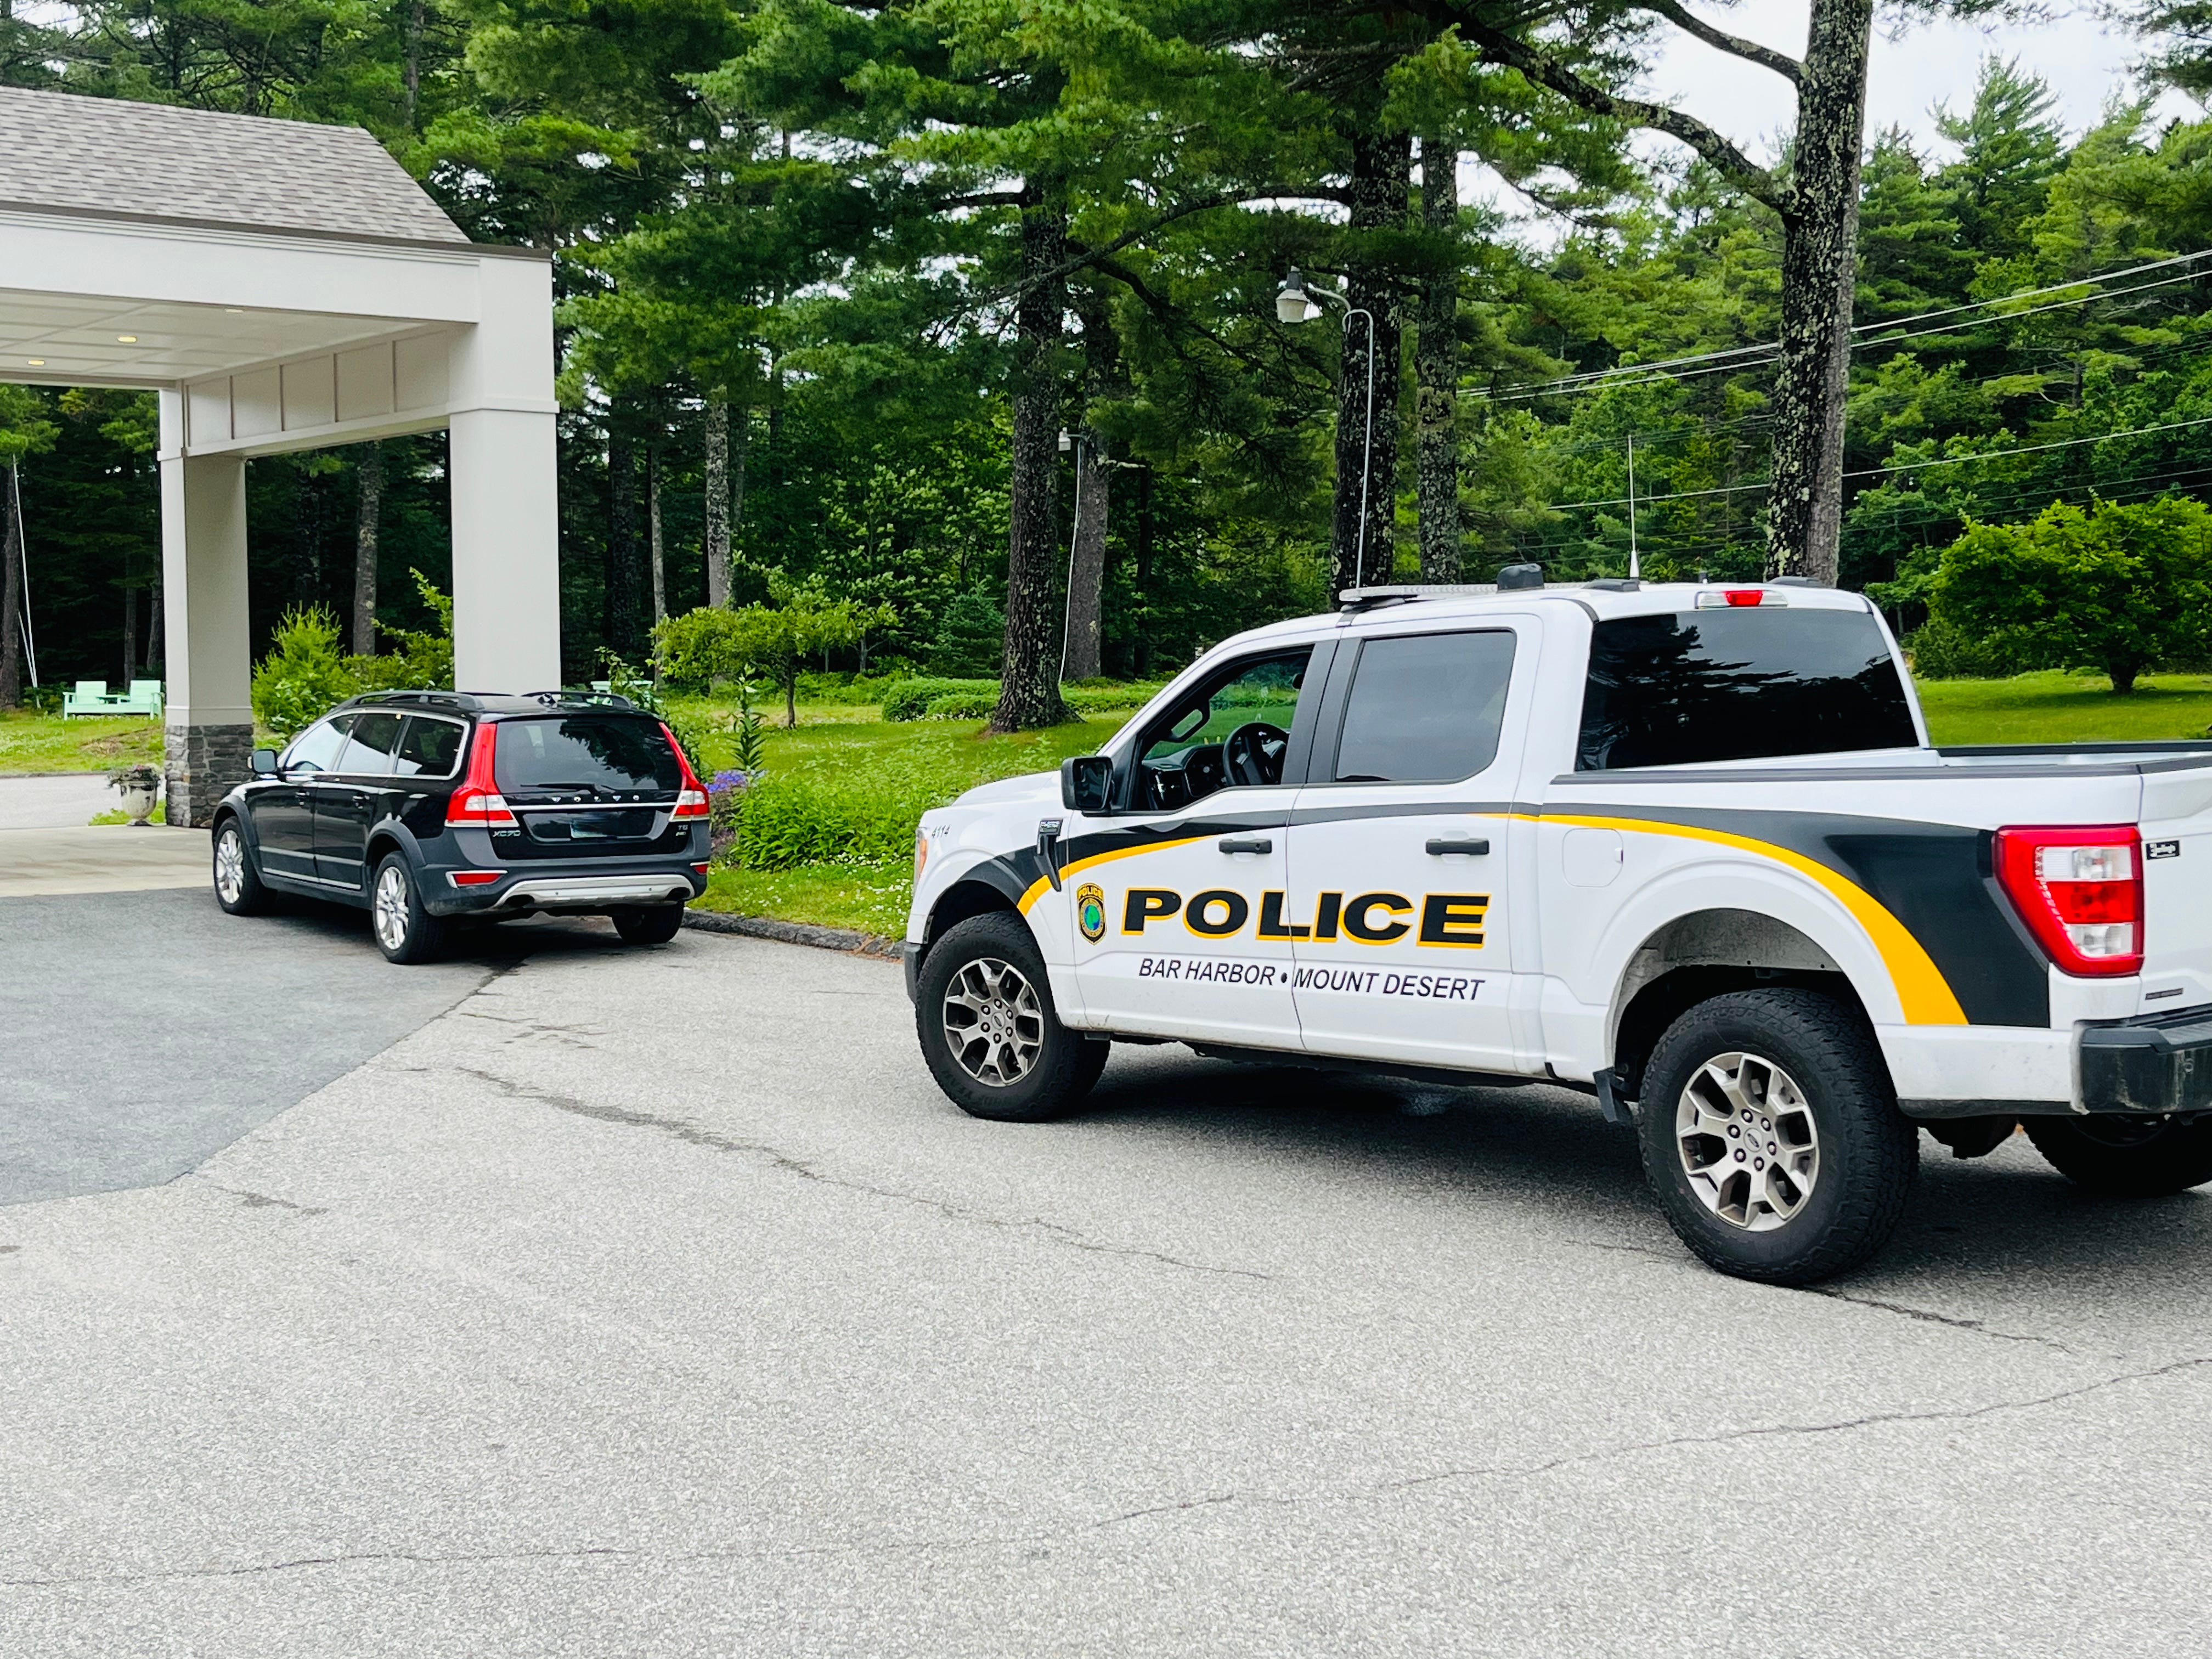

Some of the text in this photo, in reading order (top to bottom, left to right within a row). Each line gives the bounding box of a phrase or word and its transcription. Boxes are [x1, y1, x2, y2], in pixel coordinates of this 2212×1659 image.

[551, 794, 640, 803] VOLVO
[932, 824, 951, 838] 4114
[1078, 885, 1103, 901] POLICE
[1120, 887, 1492, 949] POLICE
[1139, 958, 1486, 1000] BAR HARBOR MOUNT DESERT
